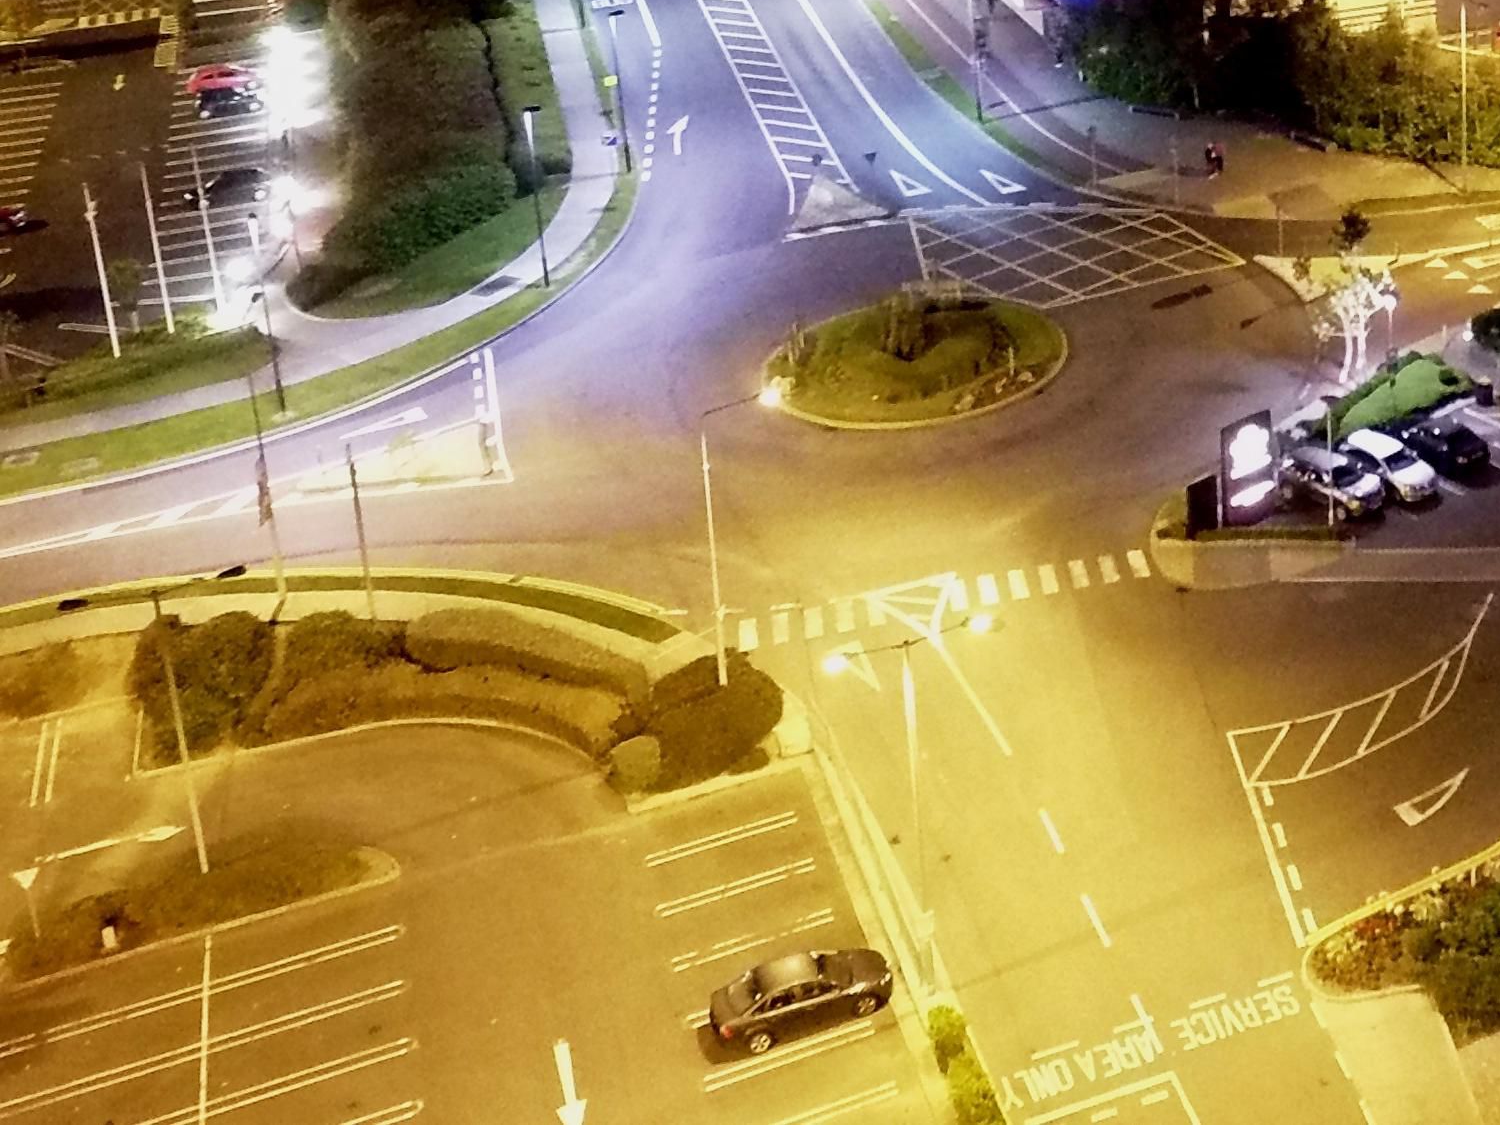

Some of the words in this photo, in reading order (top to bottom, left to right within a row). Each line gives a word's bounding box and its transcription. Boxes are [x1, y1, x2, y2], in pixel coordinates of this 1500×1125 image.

[1170, 984, 1300, 1051] SERVICE
[1073, 1027, 1165, 1079] AREA
[1000, 1057, 1075, 1112] ONLY
